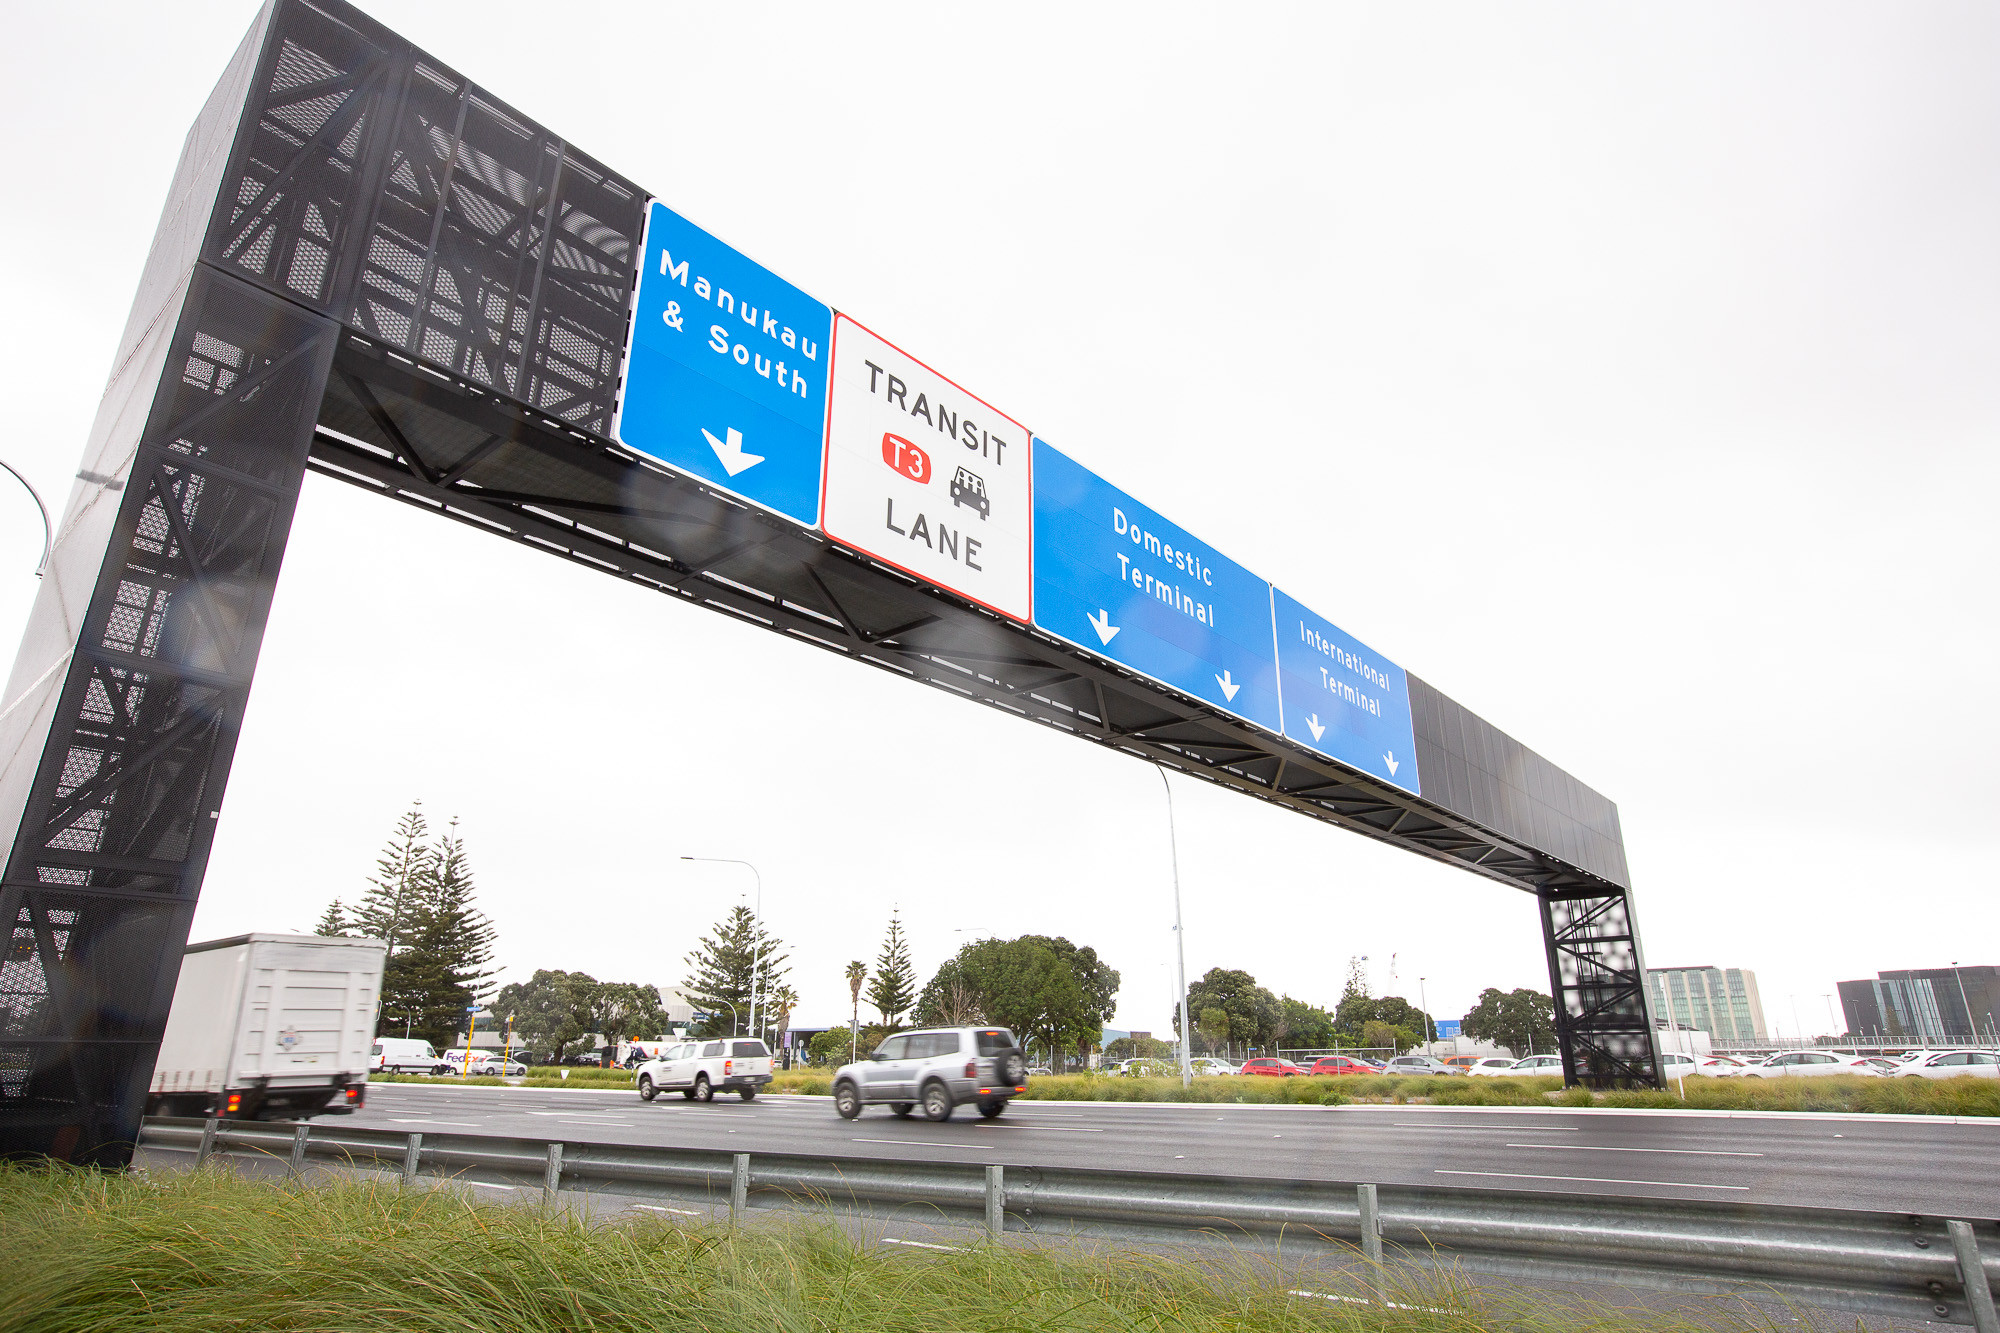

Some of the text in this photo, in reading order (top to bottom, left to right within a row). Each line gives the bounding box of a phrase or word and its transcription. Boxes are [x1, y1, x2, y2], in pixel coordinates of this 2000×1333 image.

[659, 248, 818, 362] Manukau
[662, 300, 808, 399] & South
[864, 359, 1007, 467] TRANSIT
[888, 437, 925, 480] T3
[886, 497, 982, 573] LANE
[1113, 506, 1213, 587] Domestic
[1116, 552, 1215, 628] Terminal
[1300, 620, 1390, 692] International
[1320, 666, 1381, 718] Terminal
[446, 1052, 479, 1063] FedEx
